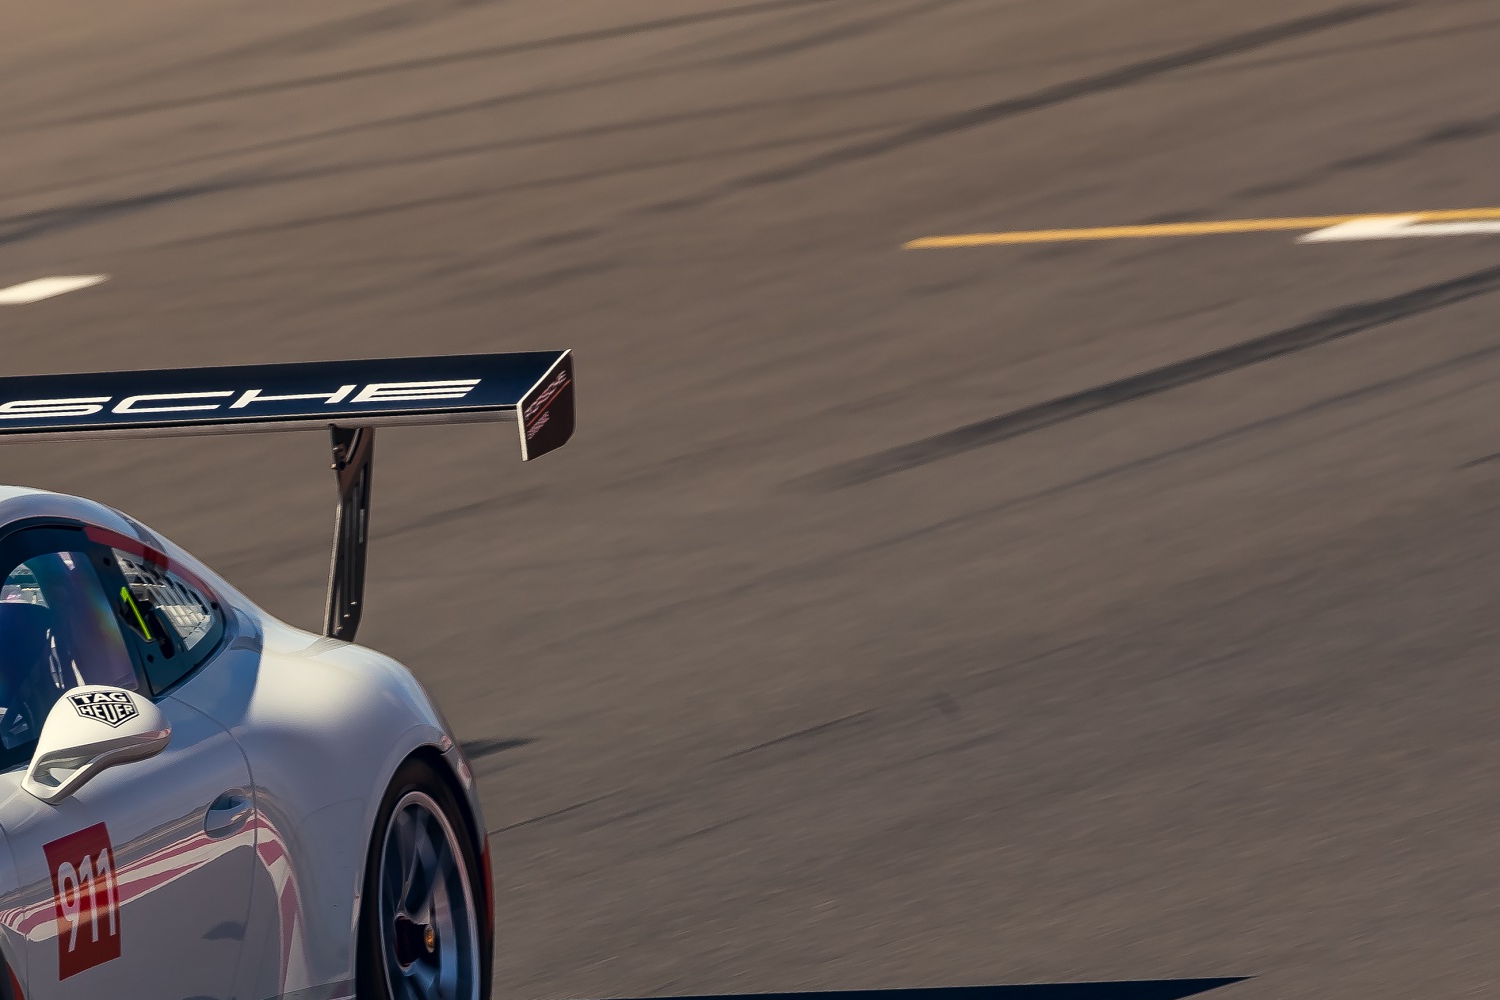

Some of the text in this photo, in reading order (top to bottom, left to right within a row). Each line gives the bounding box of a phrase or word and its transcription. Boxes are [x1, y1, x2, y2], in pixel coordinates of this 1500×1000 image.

[74, 692, 128, 704] TAG
[80, 704, 134, 723] HEUER
[58, 847, 116, 952] 911
